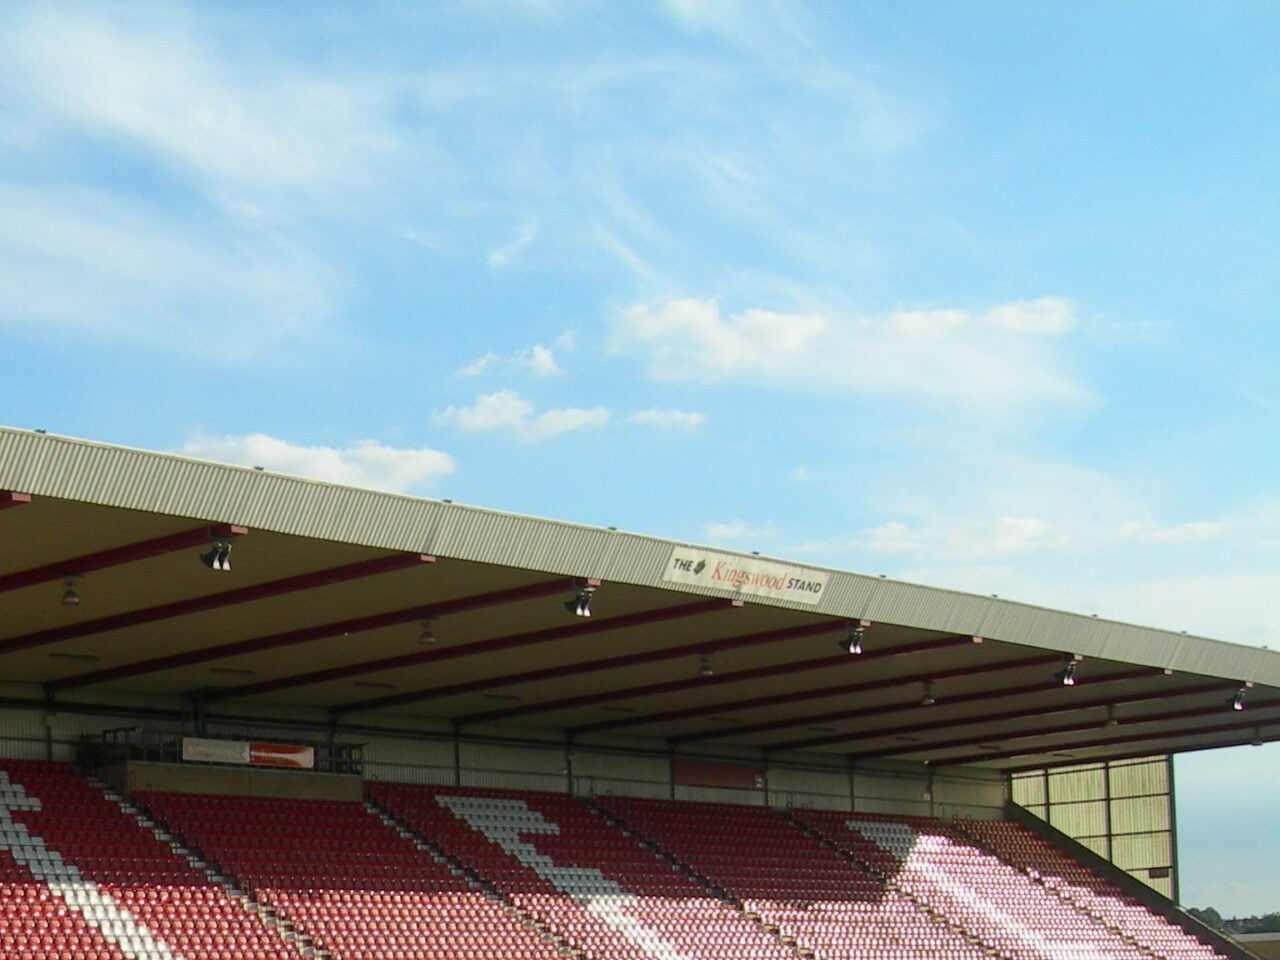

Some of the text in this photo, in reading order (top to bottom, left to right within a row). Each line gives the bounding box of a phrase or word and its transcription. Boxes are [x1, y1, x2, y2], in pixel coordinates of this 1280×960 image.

[673, 557, 823, 594] THE Kingswood STAND
